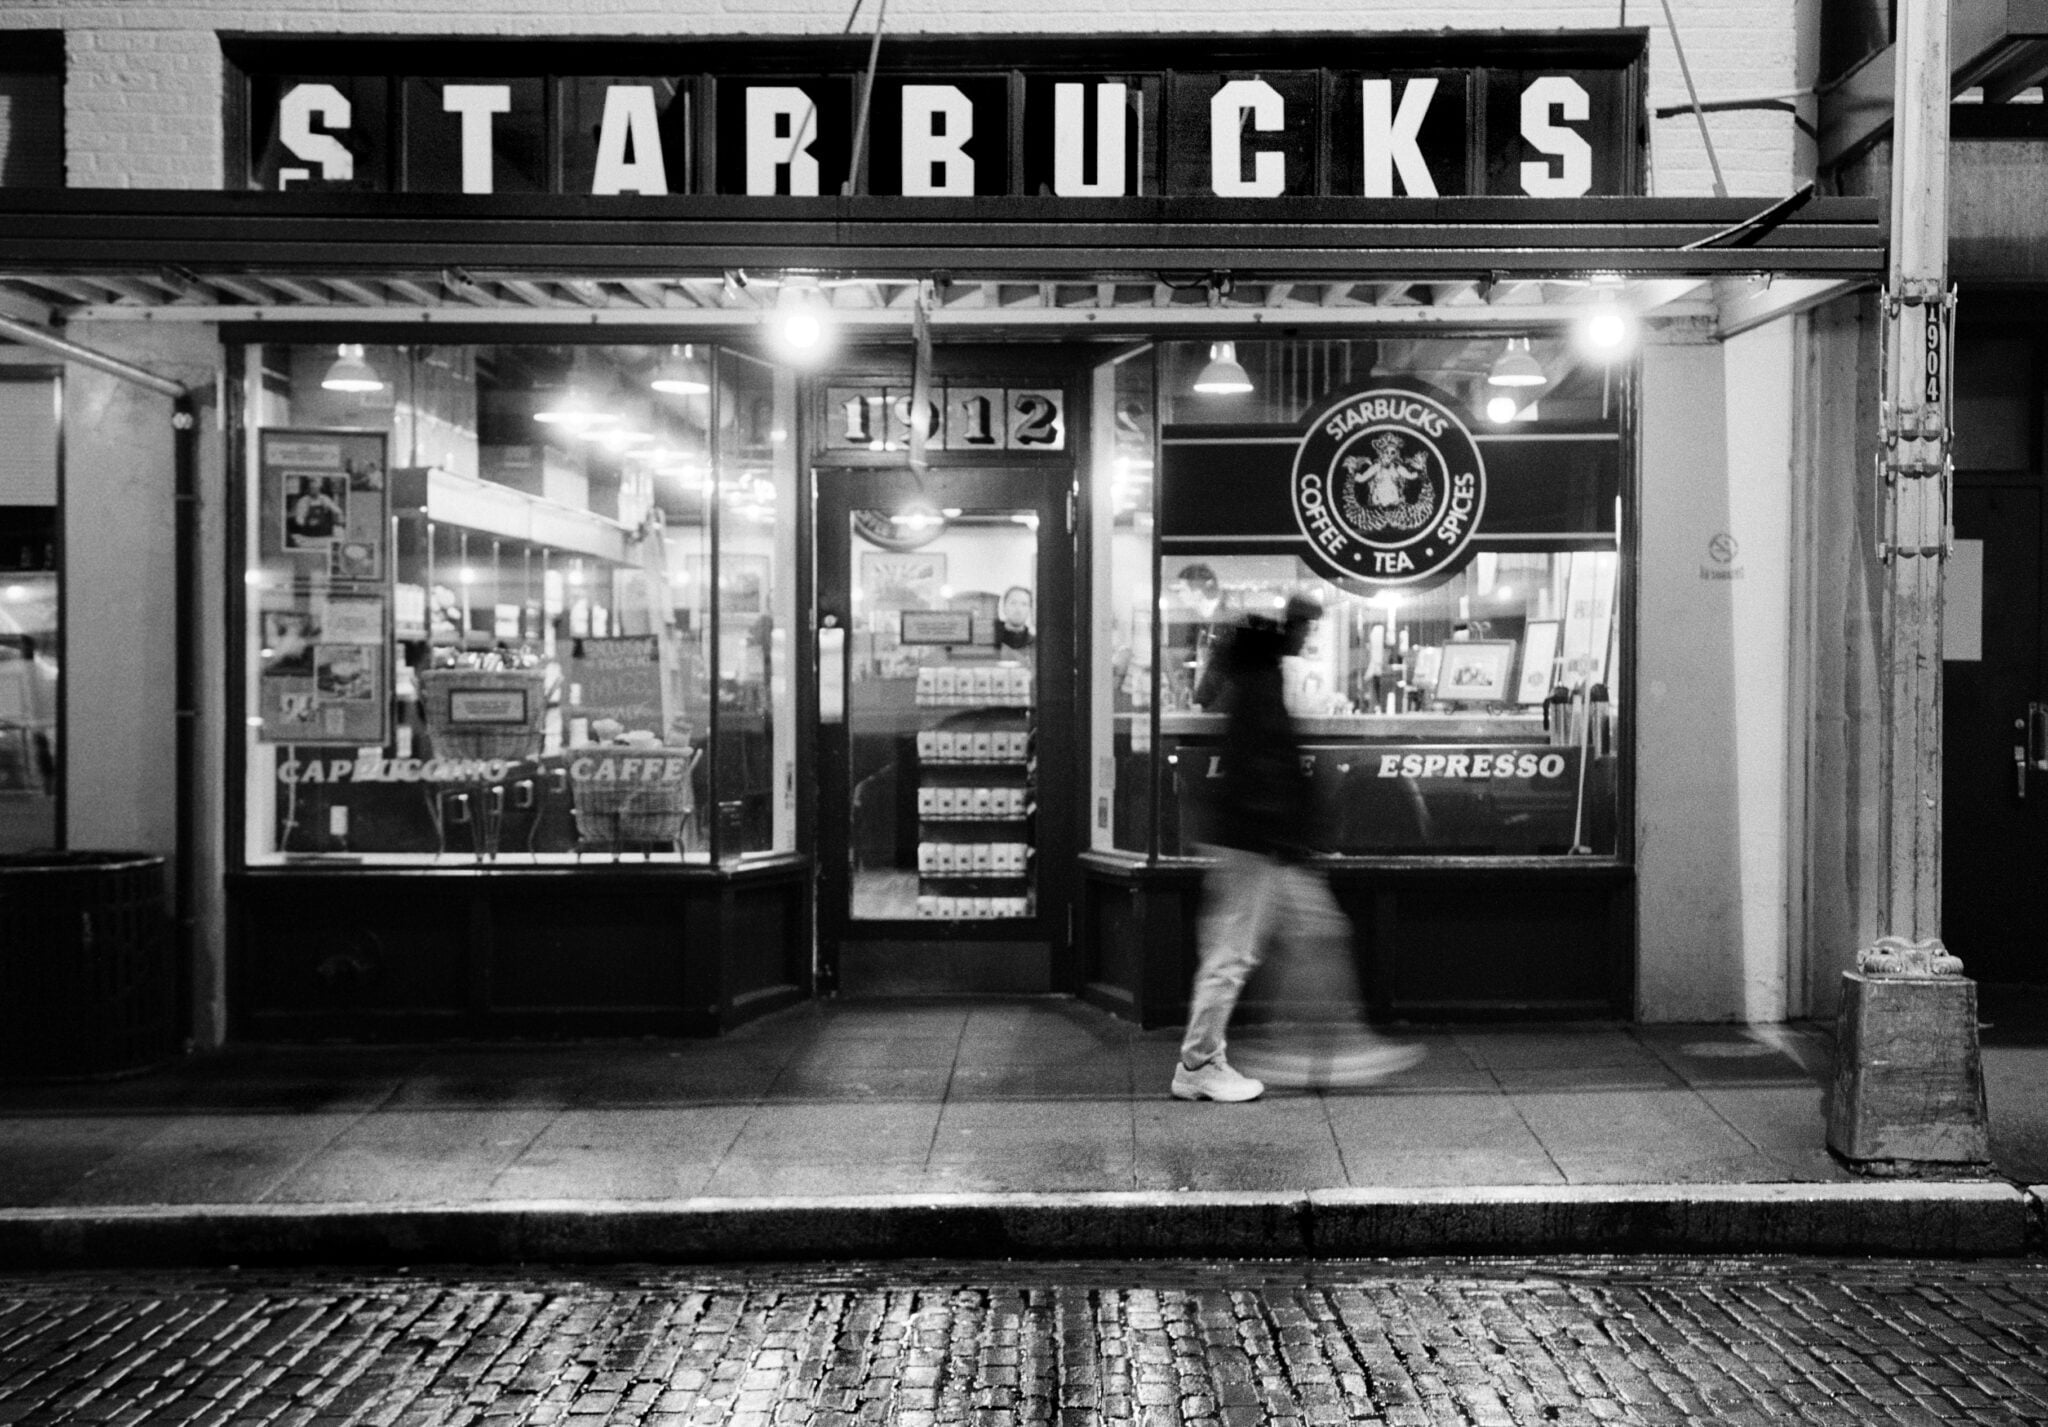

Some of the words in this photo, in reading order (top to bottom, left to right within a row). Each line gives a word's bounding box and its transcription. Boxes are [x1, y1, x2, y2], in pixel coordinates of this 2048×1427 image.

[280, 76, 1593, 199] STARBUCKS
[1926, 306, 1939, 401] 1904
[843, 393, 1058, 445] 1912
[1326, 398, 1448, 441] STARBUCKS
[1301, 473, 1348, 556] COFFEE
[1374, 551, 1415, 573] TEA
[1437, 472, 1475, 545] SPICES
[1378, 754, 1565, 778] ESPRESSO
